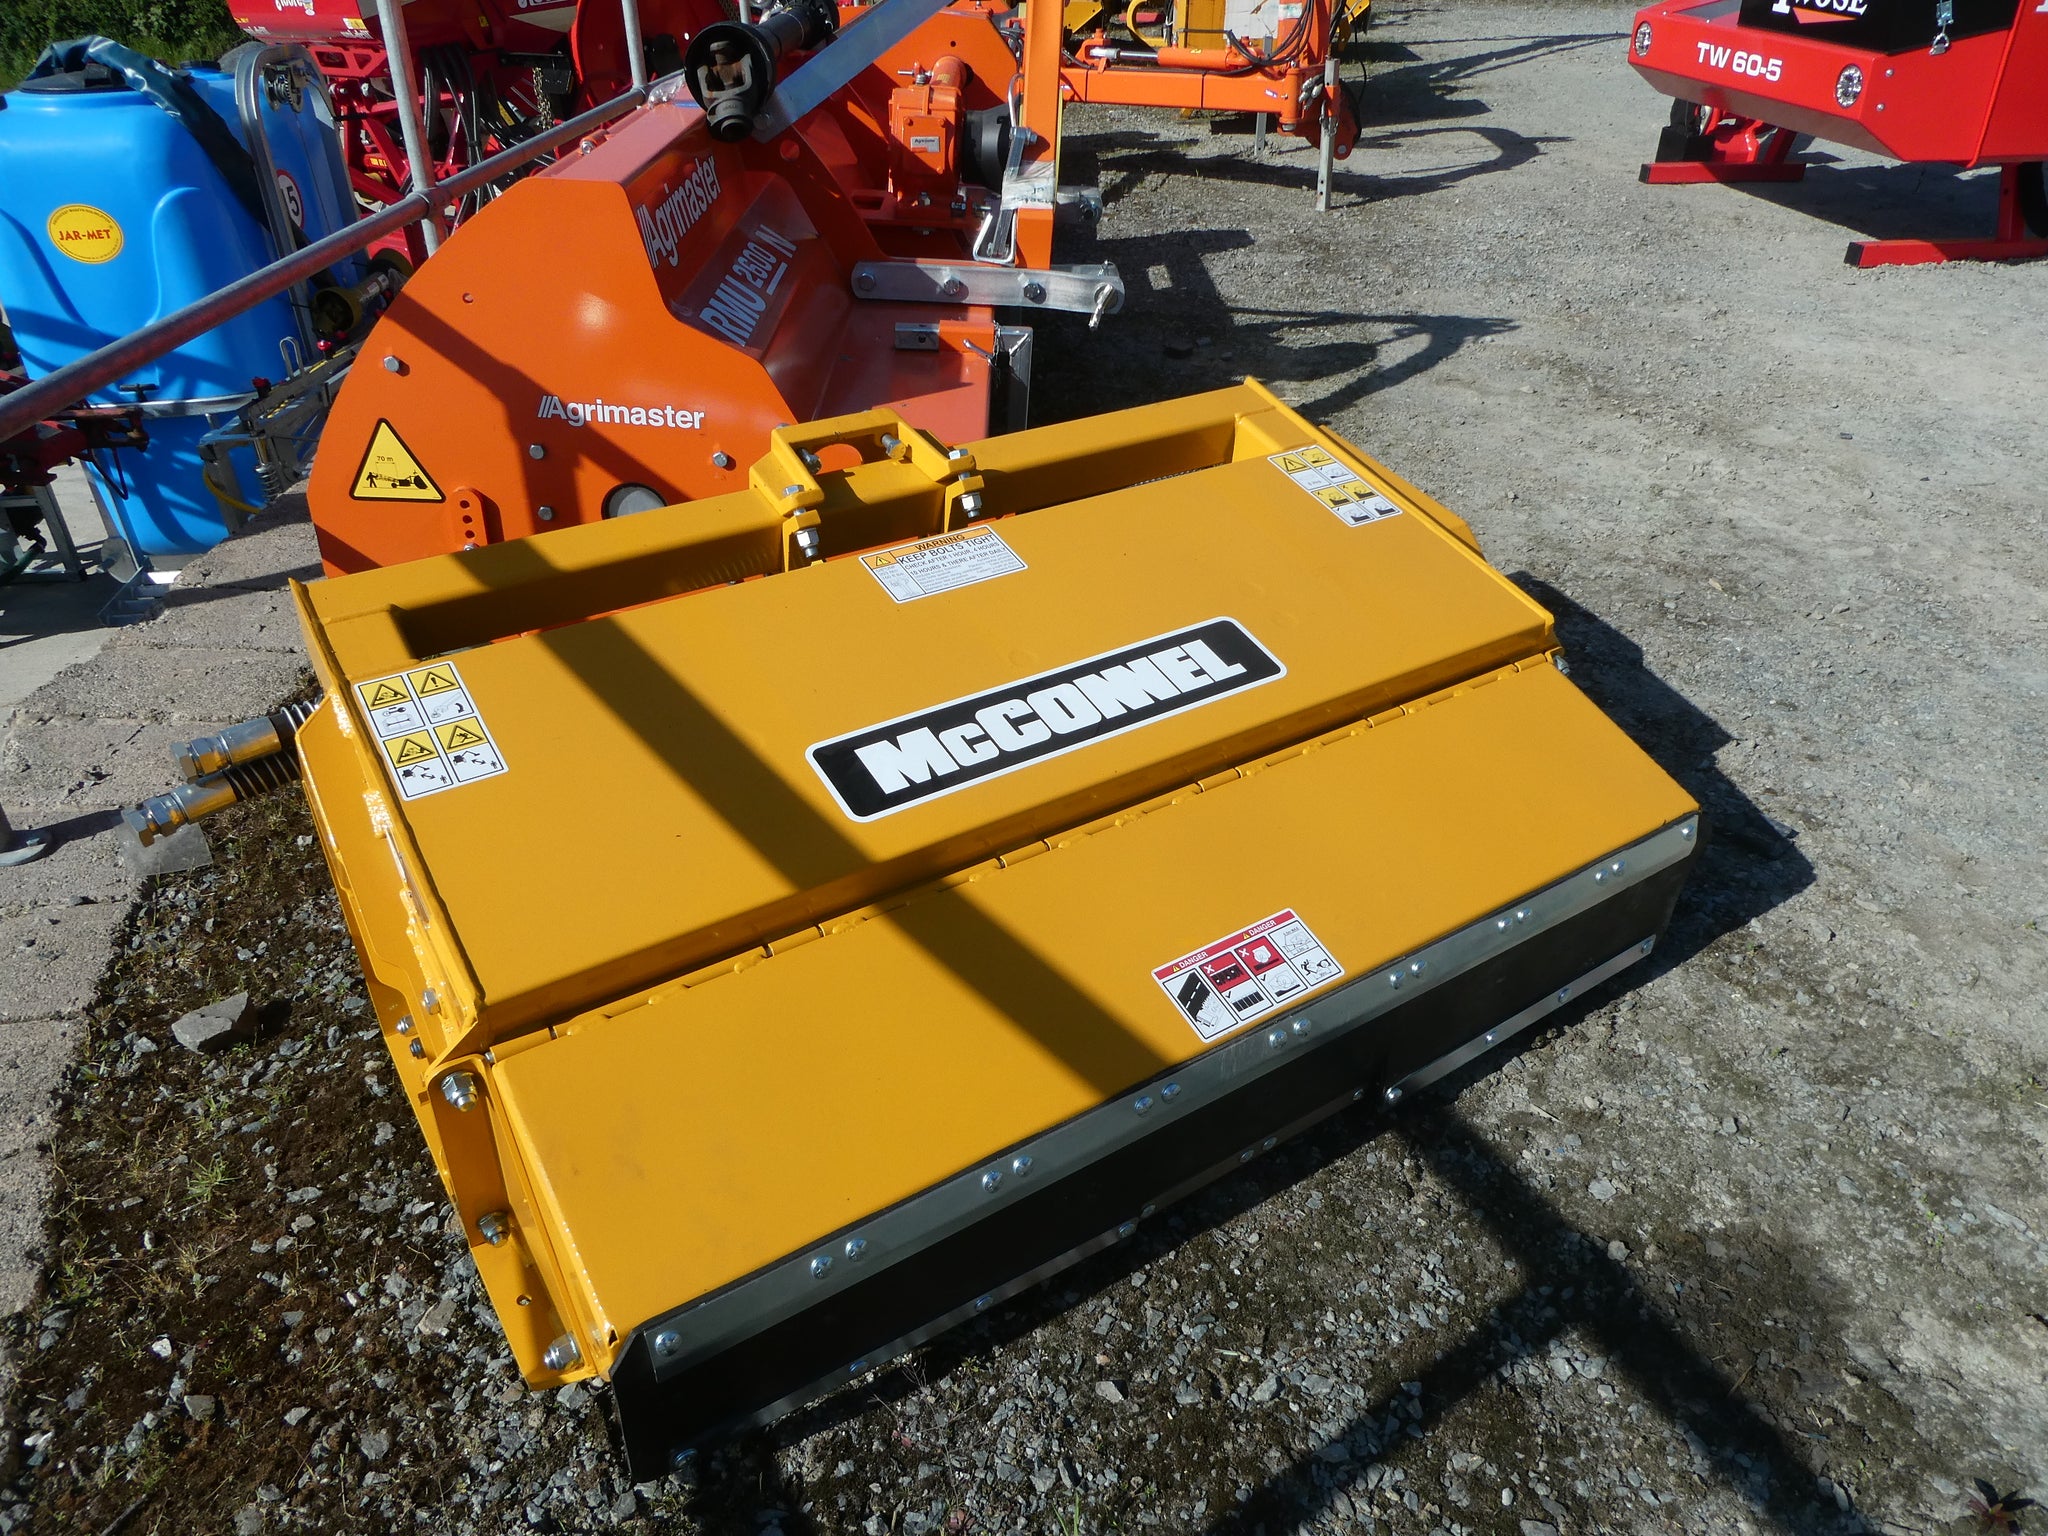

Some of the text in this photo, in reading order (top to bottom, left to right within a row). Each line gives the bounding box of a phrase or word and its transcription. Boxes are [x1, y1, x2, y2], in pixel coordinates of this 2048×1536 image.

[1697, 41, 1783, 82] TW 60-5
[640, 155, 722, 268] Agrimaster
[58, 229, 111, 241] JAR-MET
[699, 223, 798, 347] RMU 2600 N
[544, 396, 705, 430] Agrimaster
[898, 534, 995, 565] KEEP BOLTS TIGHT
[915, 534, 965, 551] WARNING
[904, 560, 926, 570] CHECK
[927, 554, 949, 565] AFTER
[918, 564, 941, 574] HOURS
[1248, 919, 1277, 936] DANGER
[1178, 951, 1209, 969] DANGER
